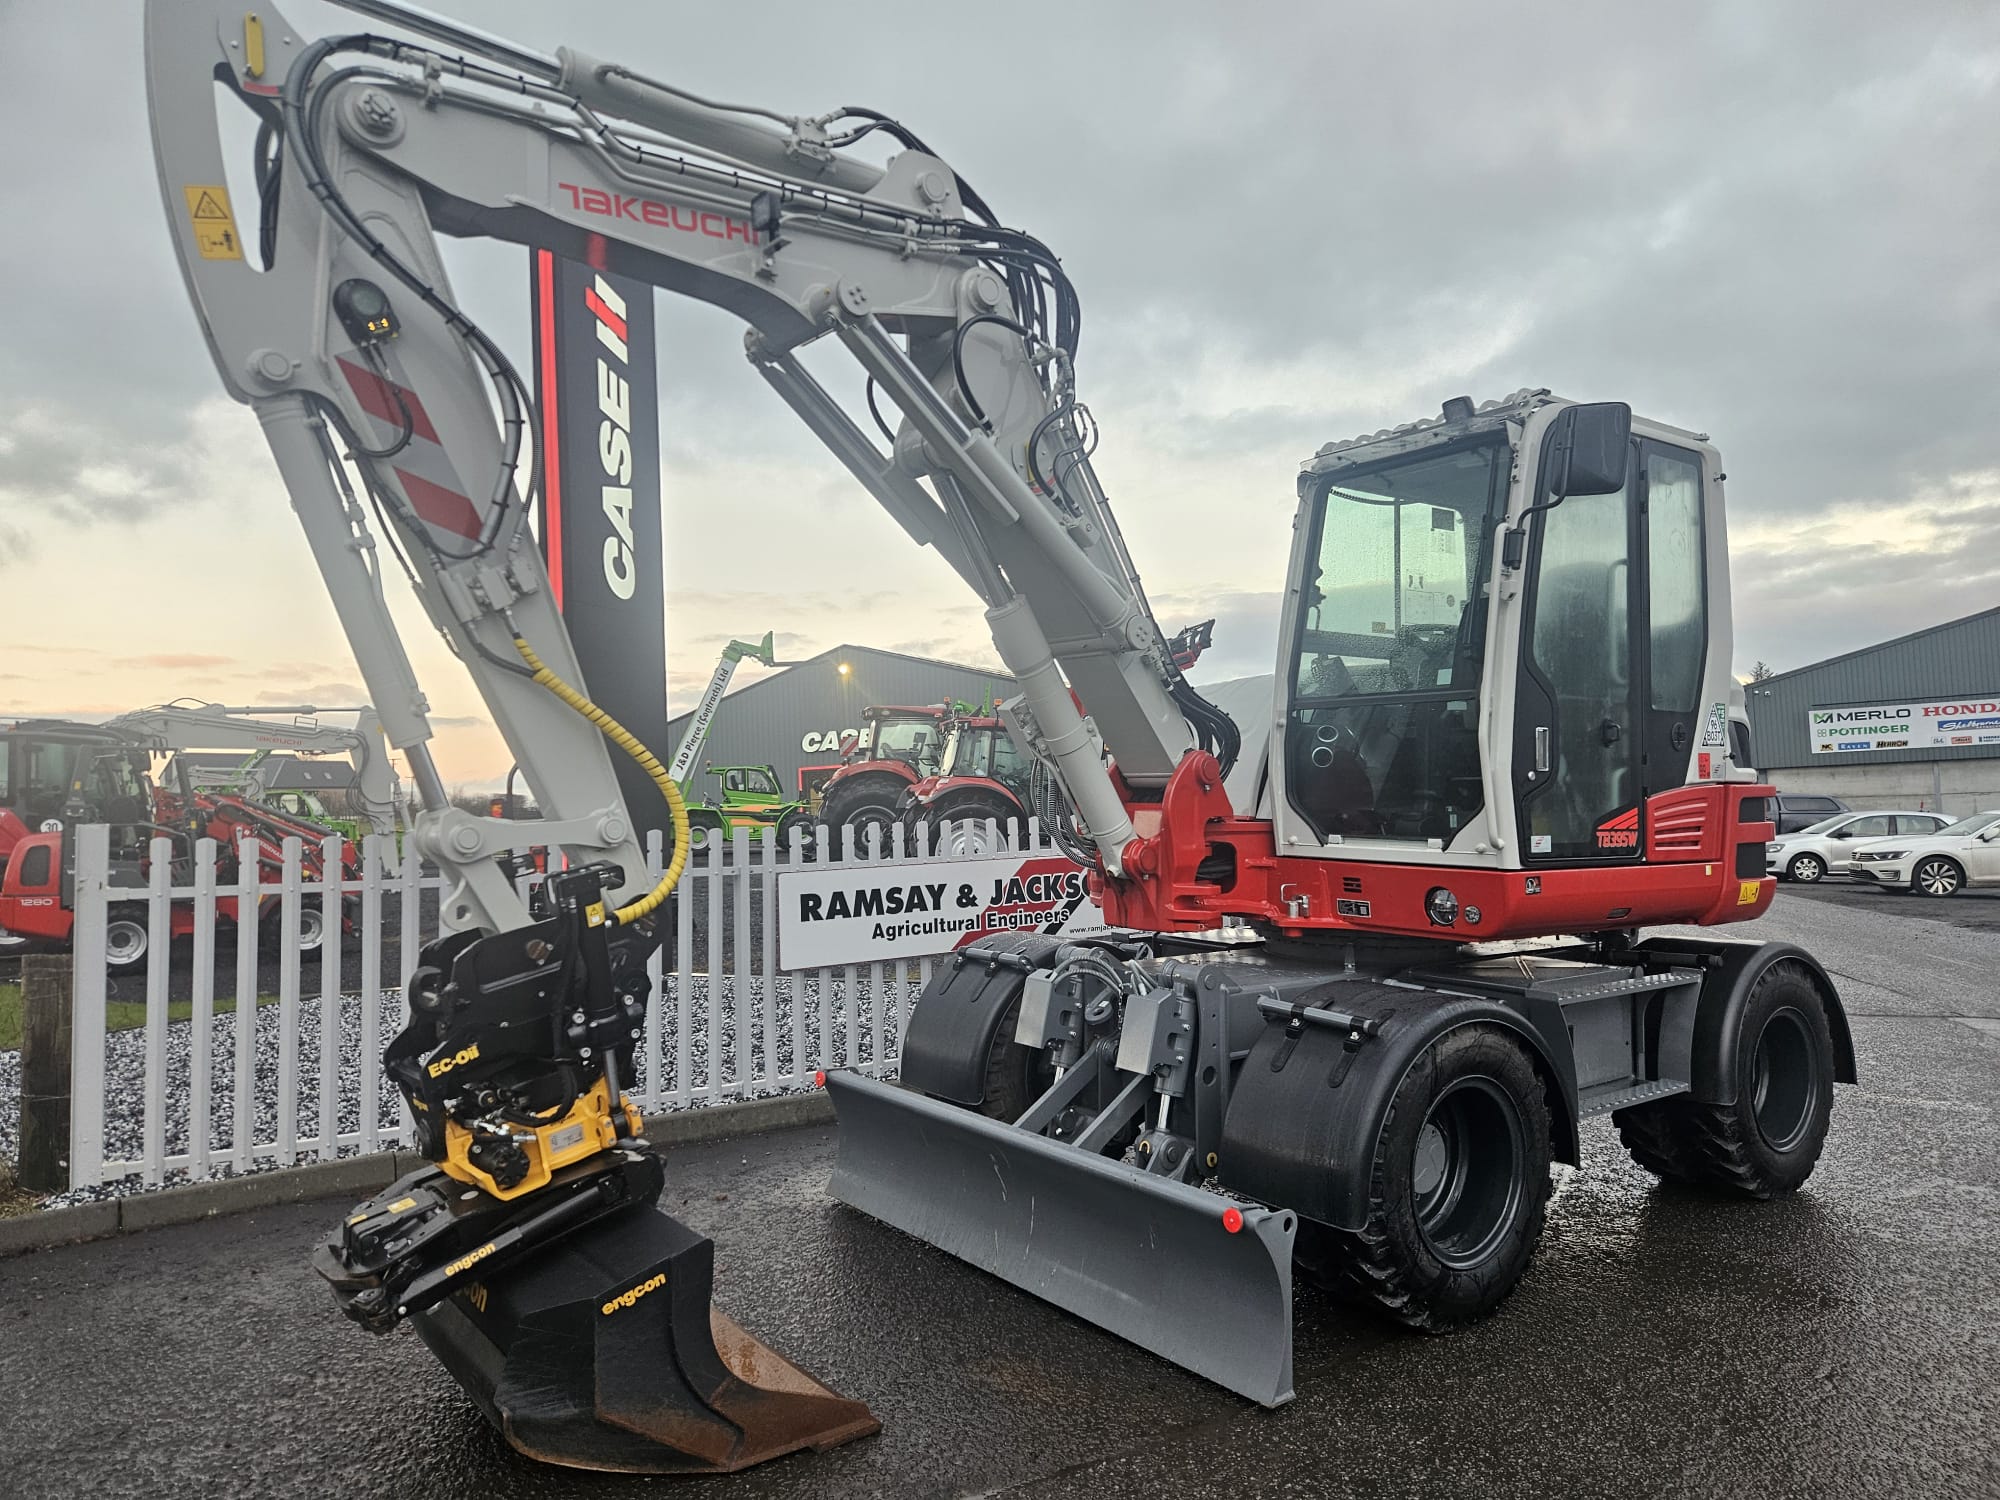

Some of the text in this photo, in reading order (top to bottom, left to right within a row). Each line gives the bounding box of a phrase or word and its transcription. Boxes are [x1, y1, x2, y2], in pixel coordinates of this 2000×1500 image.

[598, 358, 635, 600] CASE
[675, 668, 730, 771] J&D Pierce (Contracts) Ltd
[1837, 708, 1911, 722] MERLO
[44, 822, 58, 832] 30
[20, 898, 53, 906] 1280
[799, 883, 948, 923] RAMSAY
[955, 883, 979, 908] &
[871, 908, 1070, 942] Agricultural Engineers
[427, 1043, 480, 1079] EC-Oil
[444, 1242, 496, 1277] engcon
[601, 1272, 666, 1316] engcon
